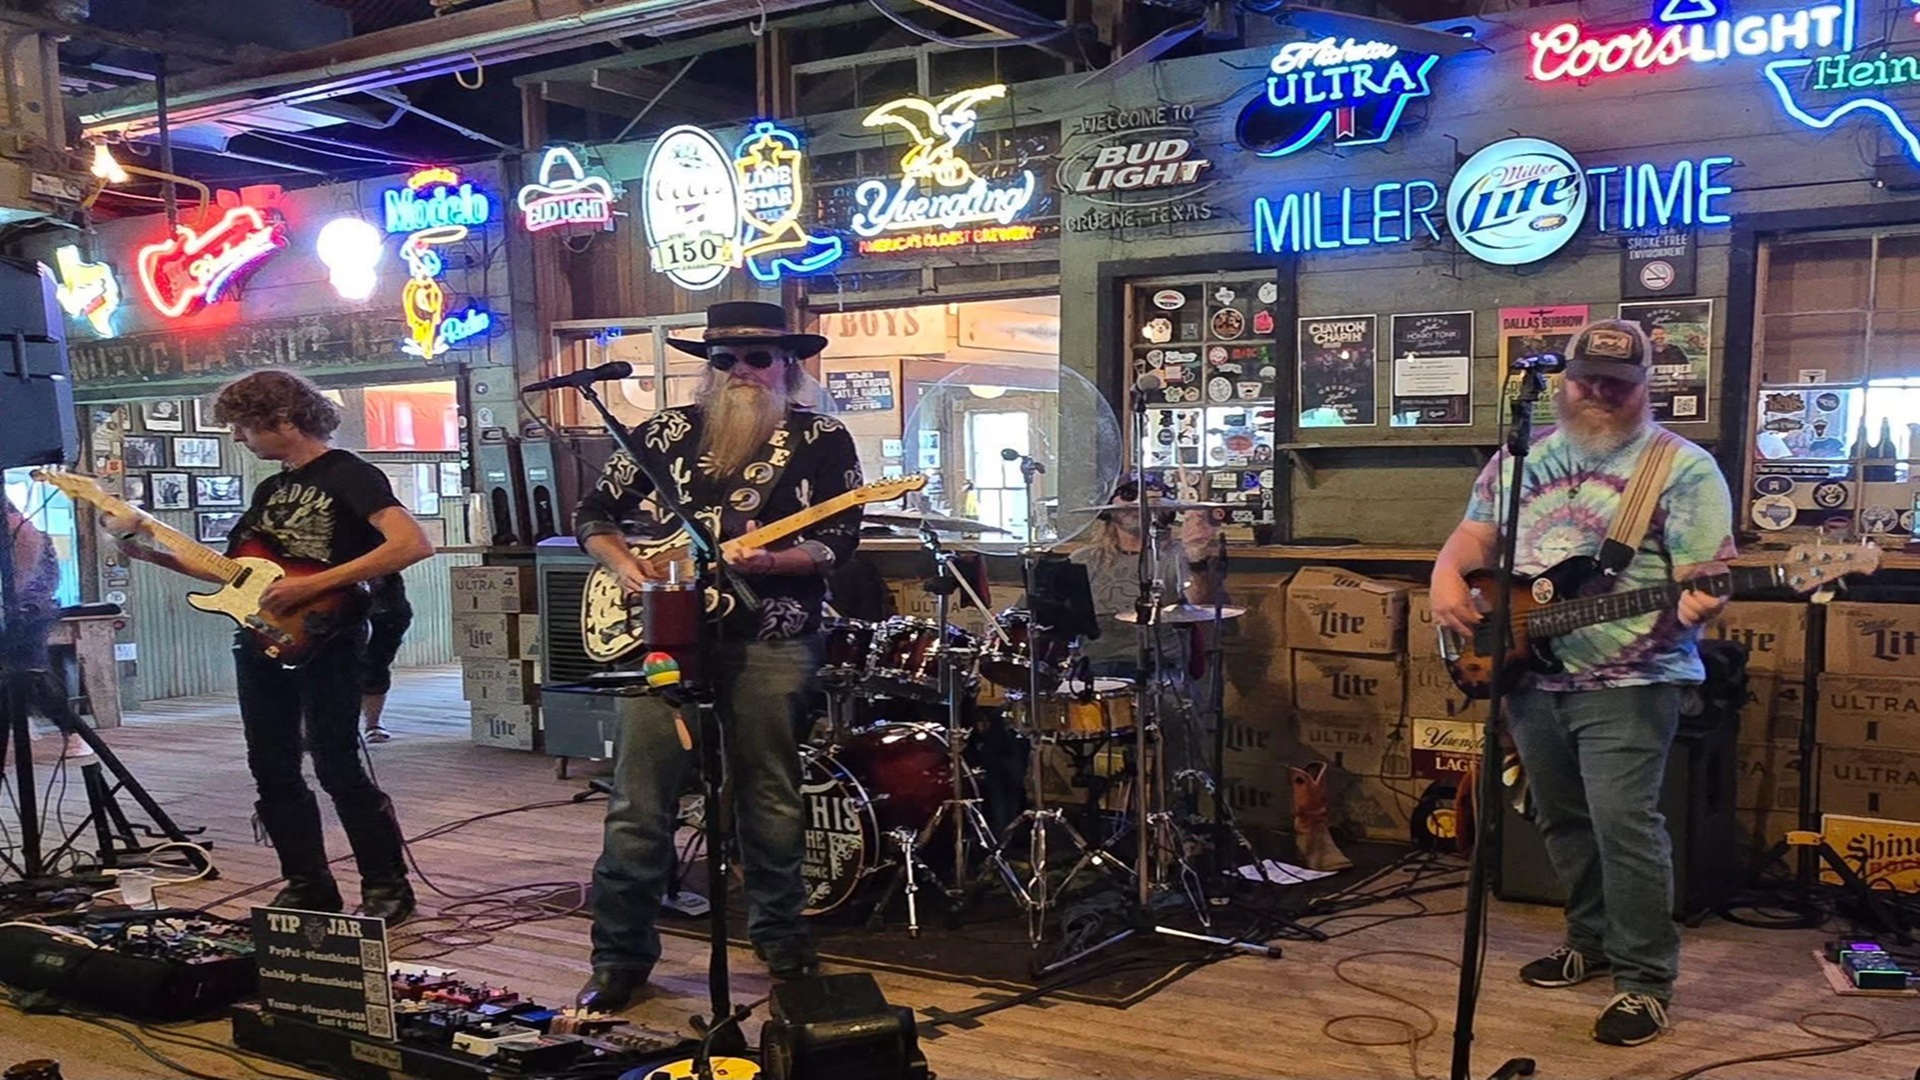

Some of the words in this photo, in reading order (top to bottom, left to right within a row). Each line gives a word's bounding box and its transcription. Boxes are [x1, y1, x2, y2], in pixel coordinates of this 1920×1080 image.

[1531, 23, 1692, 82] Coors
[1689, 6, 1842, 62] LIGHT
[1266, 61, 1417, 106] ULTRA
[1080, 106, 1167, 133] WELCOME
[1172, 104, 1195, 121] TO
[1095, 138, 1190, 168] BUD
[1075, 159, 1211, 192] LIGHT
[1491, 162, 1559, 188] Miller
[851, 169, 1035, 237] Yuengling
[1461, 172, 1580, 237] Lite
[1585, 156, 1734, 232] TIME
[384, 182, 490, 233] Modelo
[560, 200, 605, 221] LIGHT
[1149, 203, 1213, 223] TEXAS
[1253, 179, 1441, 255] MILLER
[667, 237, 718, 264] 150
[1627, 233, 1688, 250] SMOKE-FREE
[1629, 245, 1687, 260] ENVIRONMENT
[1308, 320, 1367, 336] CLAYTON
[1502, 316, 1540, 330] DALLAS
[1541, 314, 1584, 328] BURROW
[1313, 332, 1364, 345] CHAPIN
[455, 579, 498, 591] ULTRA
[910, 599, 961, 615] ULTA
[1318, 610, 1366, 639] Lite
[467, 627, 494, 649] Lite
[466, 669, 503, 680] ULTRA
[1330, 671, 1379, 699] Lite
[1830, 693, 1920, 713] ULTRA
[489, 718, 517, 739] Lite
[1308, 729, 1374, 745] ULTRA
[1833, 764, 1920, 786] ULTRA
[267, 913, 301, 934] TIP
[326, 918, 364, 938] JAR
